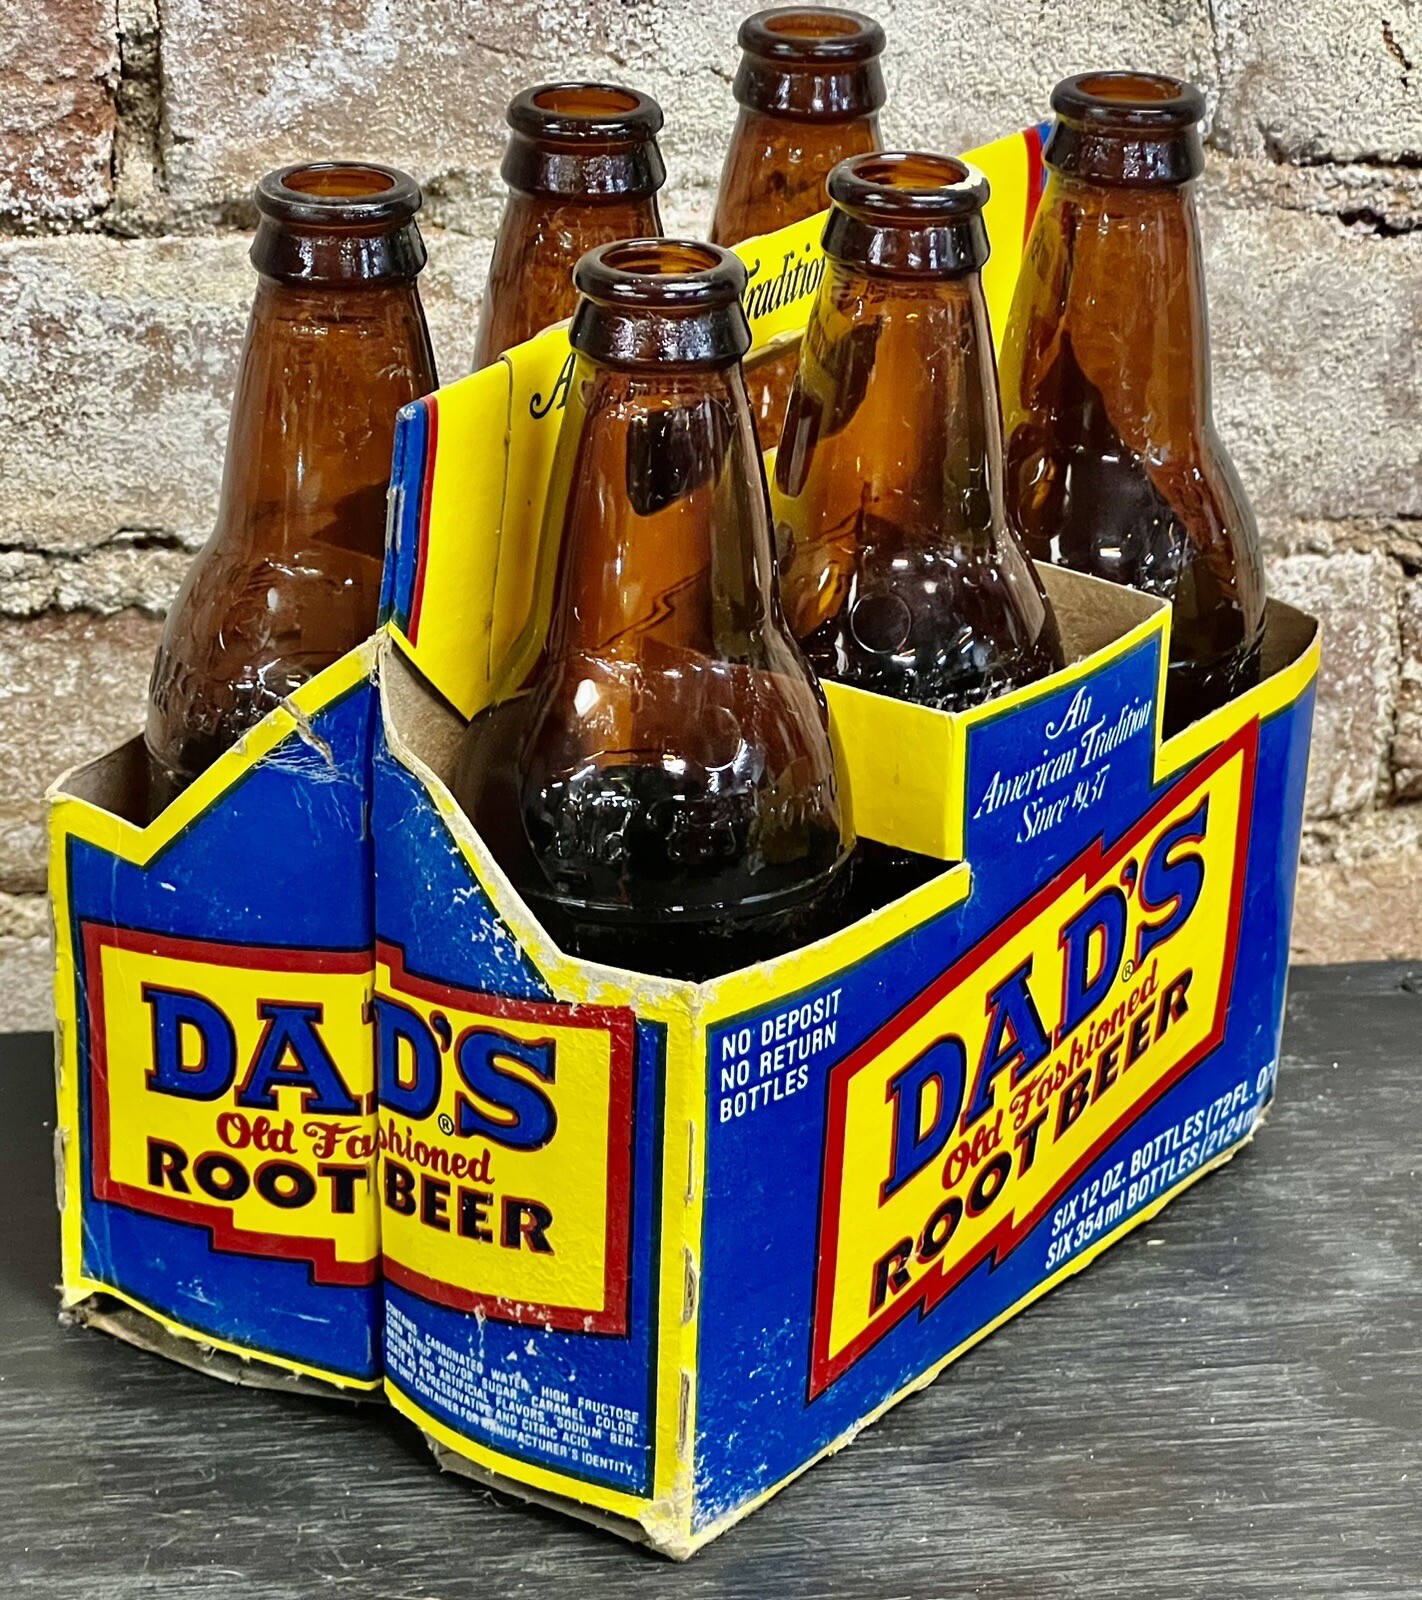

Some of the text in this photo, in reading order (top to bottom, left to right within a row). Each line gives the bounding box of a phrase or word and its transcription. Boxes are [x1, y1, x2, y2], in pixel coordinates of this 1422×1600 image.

[1045, 685, 1093, 740] An
[973, 696, 1152, 819] American Tradition
[1016, 763, 1111, 843] Since 1937
[722, 987, 843, 1062] NO DEPOSIT
[878, 791, 1211, 1210] DAD'S
[141, 981, 558, 1153] DAD'S
[719, 1064, 809, 1124] BOTTLES
[720, 1020, 837, 1093] NO RETURN
[941, 957, 1160, 1190] Old Fashioned
[216, 1111, 496, 1185] Old Fashioned
[868, 966, 1194, 1319] ROOT BEER
[147, 1135, 555, 1256] ROOT BEER
[1045, 1229, 1073, 1271] SIX
[1074, 1190, 1124, 1250] 354ml
[1051, 1192, 1081, 1238] SIX
[1081, 1179, 1100, 1214] 12
[1101, 1161, 1127, 1199] OZ.
[418, 1354, 435, 1374] AND
[439, 1367, 489, 1403] ARTIFICIAL
[556, 1416, 602, 1440] SODIUM
[425, 1333, 484, 1375] CARBONATED
[541, 1385, 569, 1404] HIGH
[577, 1396, 640, 1425] FRUCTOSE
[437, 1355, 474, 1383] AND/OR
[531, 1395, 586, 1424] CARAMEL
[460, 1406, 480, 1425] FOR
[495, 1408, 518, 1427] AND
[521, 1418, 558, 1441] CITRIC
